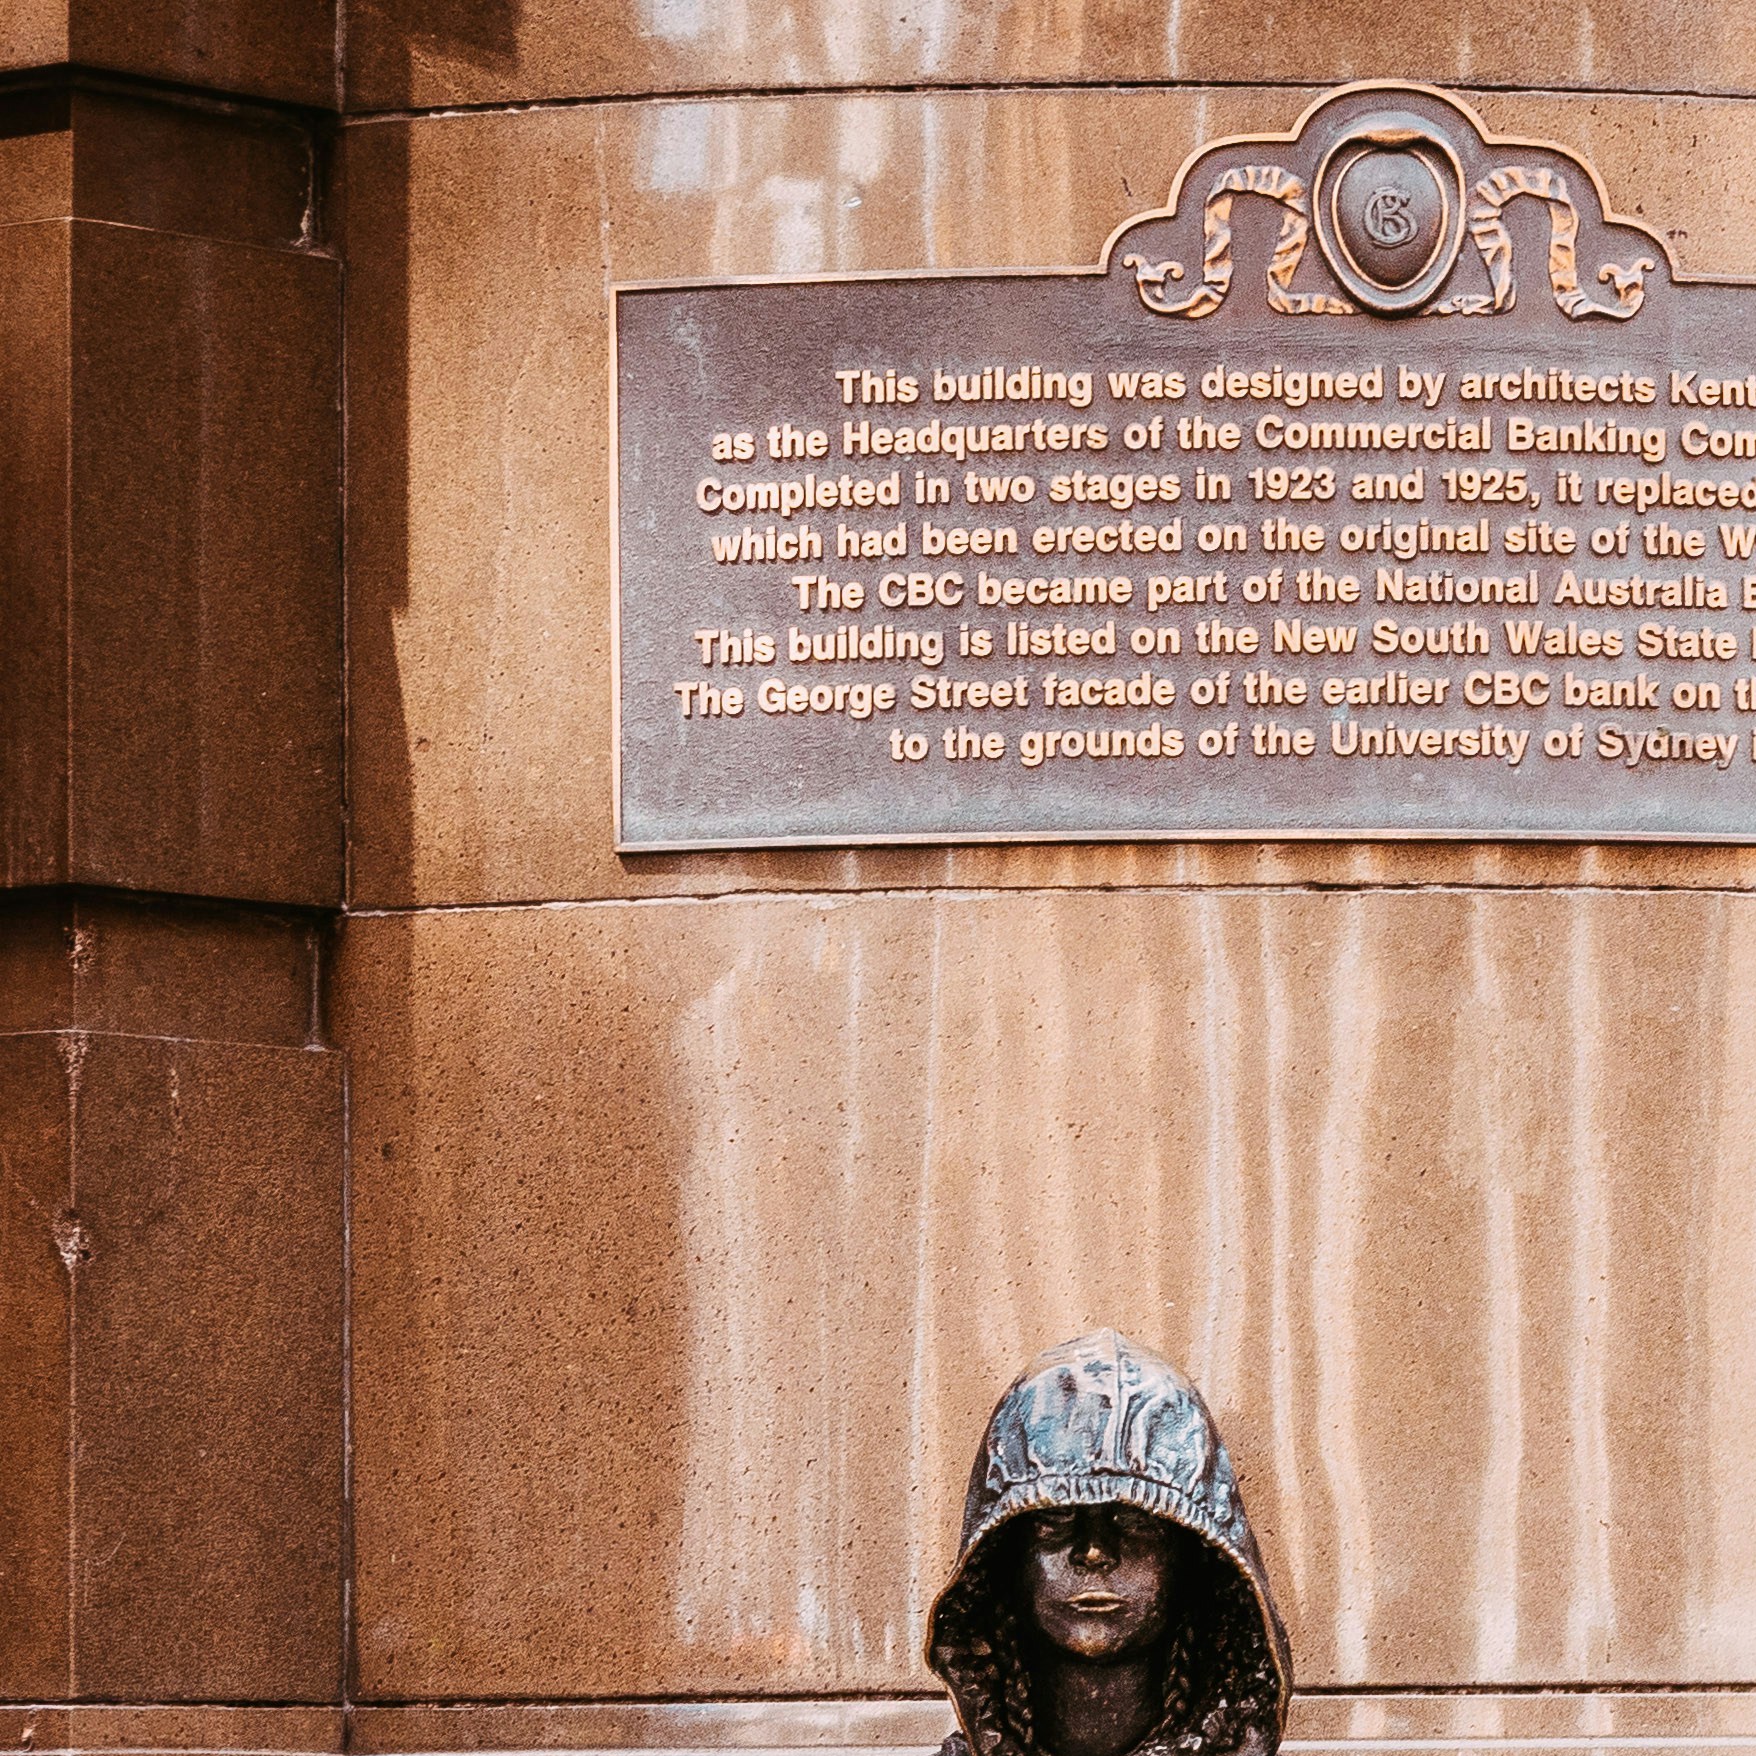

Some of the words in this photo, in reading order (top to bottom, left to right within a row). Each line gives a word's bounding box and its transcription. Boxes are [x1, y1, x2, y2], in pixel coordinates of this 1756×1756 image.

[835, 370, 919, 404] This
[933, 367, 1092, 407] building
[1108, 370, 1186, 400] was
[1201, 365, 1384, 406] designed
[1399, 366, 1445, 406] by
[1460, 367, 1655, 402] architects
[712, 431, 755, 460] as
[767, 424, 828, 458] the
[843, 420, 1108, 460] Headquarters
[1124, 417, 1164, 449] of
[1178, 416, 1242, 449] the
[1255, 415, 1492, 449] Commercial
[1508, 418, 1666, 462] Banking
[696, 473, 900, 516] Completed
[915, 471, 950, 504] in
[964, 472, 1036, 502] two
[1049, 470, 1181, 510] stages
[1195, 467, 1231, 499] in
[1248, 467, 1336, 499] 1923
[1352, 468, 1424, 499] and
[1442, 468, 1541, 507] 1925,
[1556, 469, 1582, 502] it
[712, 525, 821, 563] which
[837, 522, 906, 557] had
[922, 521, 1018, 555] been
[1032, 518, 1182, 553] erected
[1198, 524, 1247, 552] on
[1262, 518, 1324, 552] the
[1340, 518, 1489, 559] original
[1504, 520, 1576, 553] site
[1591, 521, 1629, 554] of
[1643, 522, 1705, 557] the
[792, 576, 865, 610] The
[878, 573, 964, 606] CBC
[978, 572, 1133, 605] became
[1148, 571, 1227, 611] part
[1243, 569, 1283, 602] of
[1296, 568, 1360, 602] the
[1376, 569, 1538, 604] National
[1554, 571, 1727, 608] Australia
[695, 628, 775, 664] This
[788, 625, 944, 666] building
[960, 623, 992, 656] is
[1007, 621, 1116, 655] listed
[1131, 626, 1181, 653] on
[1195, 620, 1259, 653] the
[1274, 620, 1358, 653] New
[1372, 619, 1489, 654] South
[1504, 620, 1623, 655] Wales
[1638, 623, 1737, 660] State
[674, 681, 744, 716] The
[758, 678, 896, 719] George
[910, 675, 1029, 709] Street
[1043, 671, 1175, 707] facade
[1191, 671, 1231, 704] of
[1244, 670, 1307, 704] the
[1322, 672, 1450, 705] earlier
[1464, 671, 1550, 705] CBC
[1564, 672, 1660, 708] bank
[1673, 681, 1720, 709] on
[890, 729, 928, 760] to
[943, 726, 1005, 759] the
[1019, 723, 1184, 766] grounds
[1199, 722, 1238, 755] of
[1252, 721, 1315, 755] the
[1331, 721, 1530, 764] University
[1544, 723, 1585, 757] of
[1598, 724, 1738, 767] Sydney
